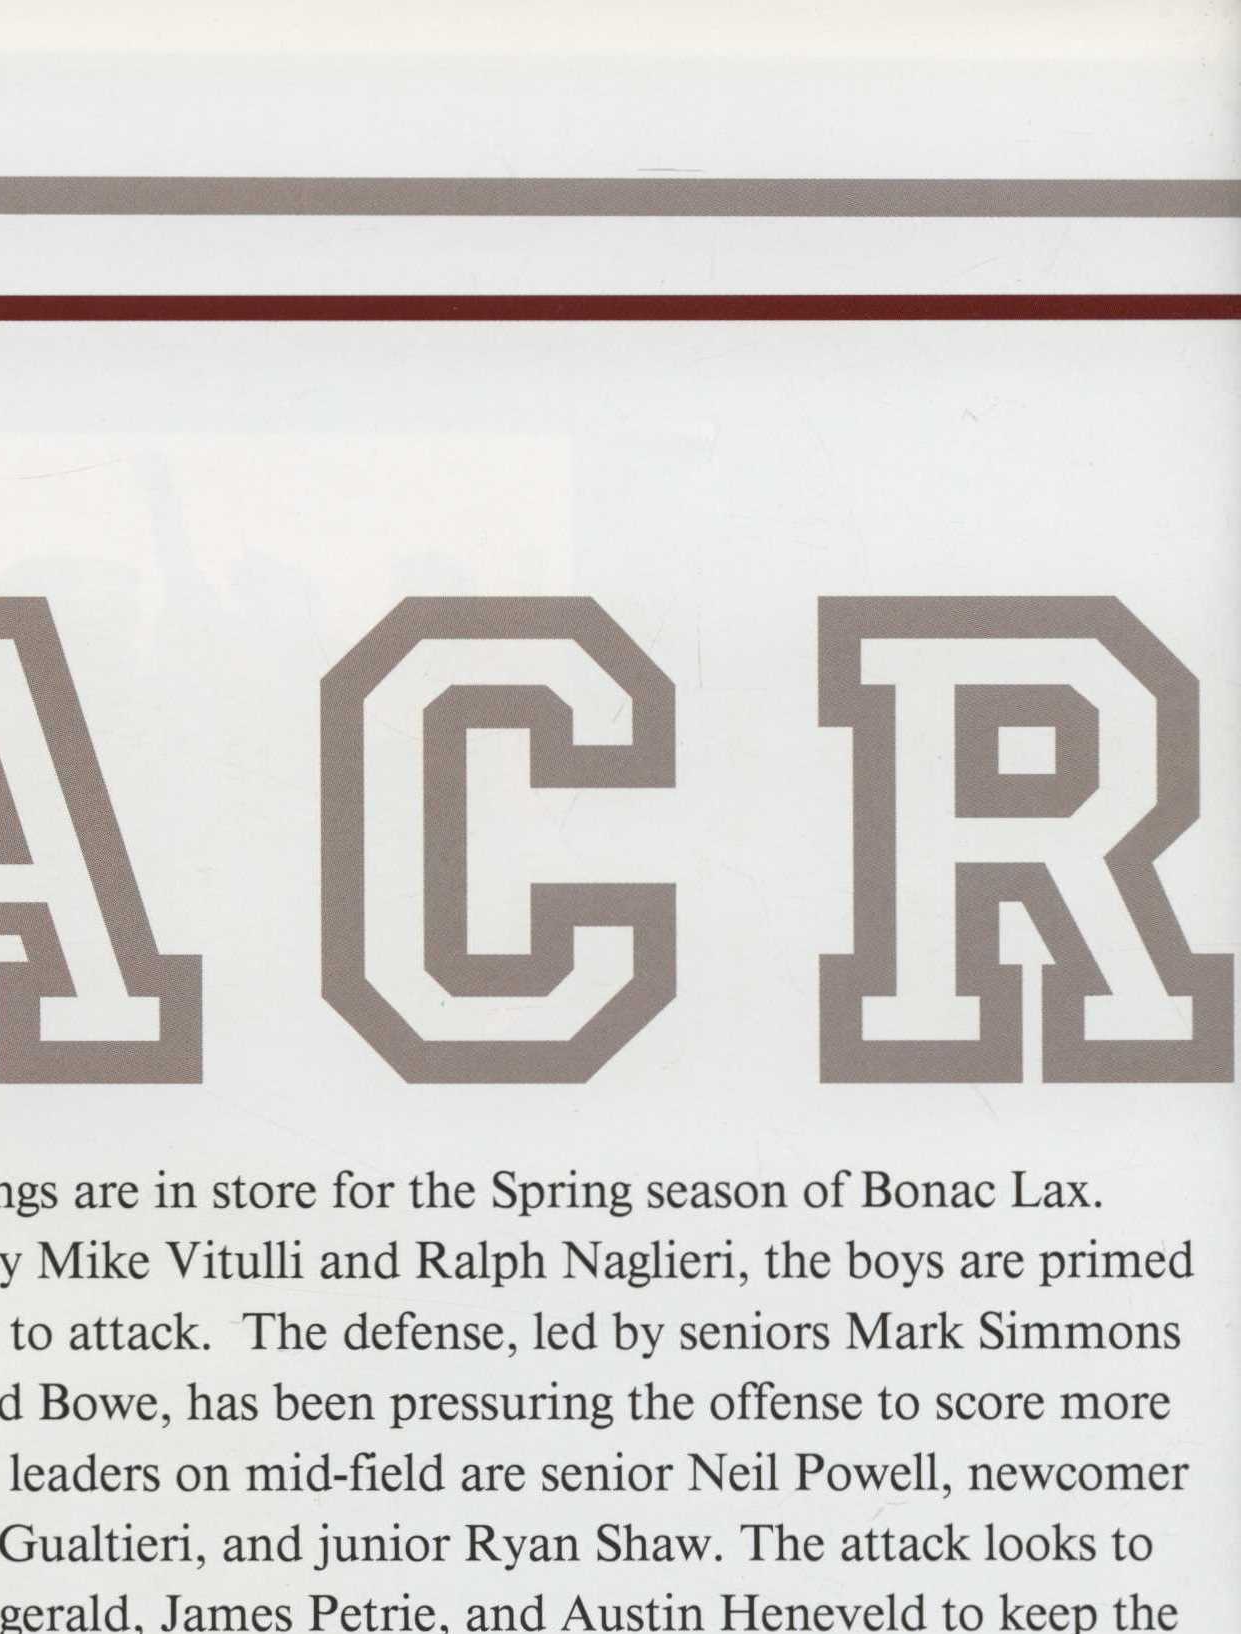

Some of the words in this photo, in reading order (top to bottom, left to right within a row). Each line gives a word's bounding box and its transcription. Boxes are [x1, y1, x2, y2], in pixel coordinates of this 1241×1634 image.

[74, 1181, 139, 1209] are
[154, 1169, 198, 1209] in
[213, 1175, 316, 1209] store
[332, 1169, 395, 1209] for
[408, 1170, 475, 1209] the
[492, 1169, 633, 1218] Spring
[647, 1181, 788, 1209] season
[803, 1169, 852, 1209] of
[862, 1170, 996, 1209] Bonac
[1011, 1170, 1102, 1209] Lax.
[38, 1239, 150, 1280] Mike
[165, 1239, 304, 1280] Vitulli
[320, 1240, 401, 1280] and
[415, 1239, 547, 1288] Ralph
[561, 1239, 748, 1289] Naglieri,
[764, 1239, 831, 1279] the
[846, 1239, 944, 1289] boys
[960, 1251, 1024, 1279] are
[1039, 1238, 1195, 1287] primed
[10, 1317, 53, 1351] to
[69, 1311, 211, 1351] attack.
[242, 1311, 327, 1351] The
[343, 1310, 517, 1358] defense,
[534, 1311, 598, 1351] led
[612, 1311, 665, 1360] by
[680, 1310, 830, 1351] seniors
[846, 1311, 964, 1350] Mark
[979, 1310, 1181, 1350] Simmons
[39, 1383, 171, 1429] Bowe,
[187, 1382, 259, 1422] has
[272, 1382, 376, 1422] been
[390, 1381, 614, 1430] pressuring
[627, 1381, 694, 1421] the
[710, 1380, 863, 1421] offense
[877, 1386, 920, 1421] to
[936, 1392, 1045, 1421] score
[1060, 1392, 1171, 1421] more
[10, 1452, 161, 1493] leaders
[176, 1464, 230, 1492] on
[246, 1451, 446, 1492] mid-field
[461, 1464, 526, 1492] are
[541, 1451, 674, 1492] senior
[687, 1451, 779, 1492] Neil
[795, 1451, 952, 1499] Powell,
[968, 1463, 1190, 1492] newcomer
[223, 1523, 303, 1563] and
[313, 1522, 451, 1572] junior
[464, 1524, 580, 1572] Ryan
[597, 1523, 723, 1562] Shaw.
[740, 1523, 824, 1562] The
[841, 1522, 971, 1562] attack
[985, 1522, 1097, 1562] looks
[1111, 1528, 1153, 1562] to
[160, 1594, 293, 1633] James
[466, 1593, 547, 1633] and
[560, 1592, 705, 1632] Austin
[720, 1593, 927, 1632] Heneveld
[941, 1599, 984, 1632] to
[1112, 1592, 1178, 1632] the
